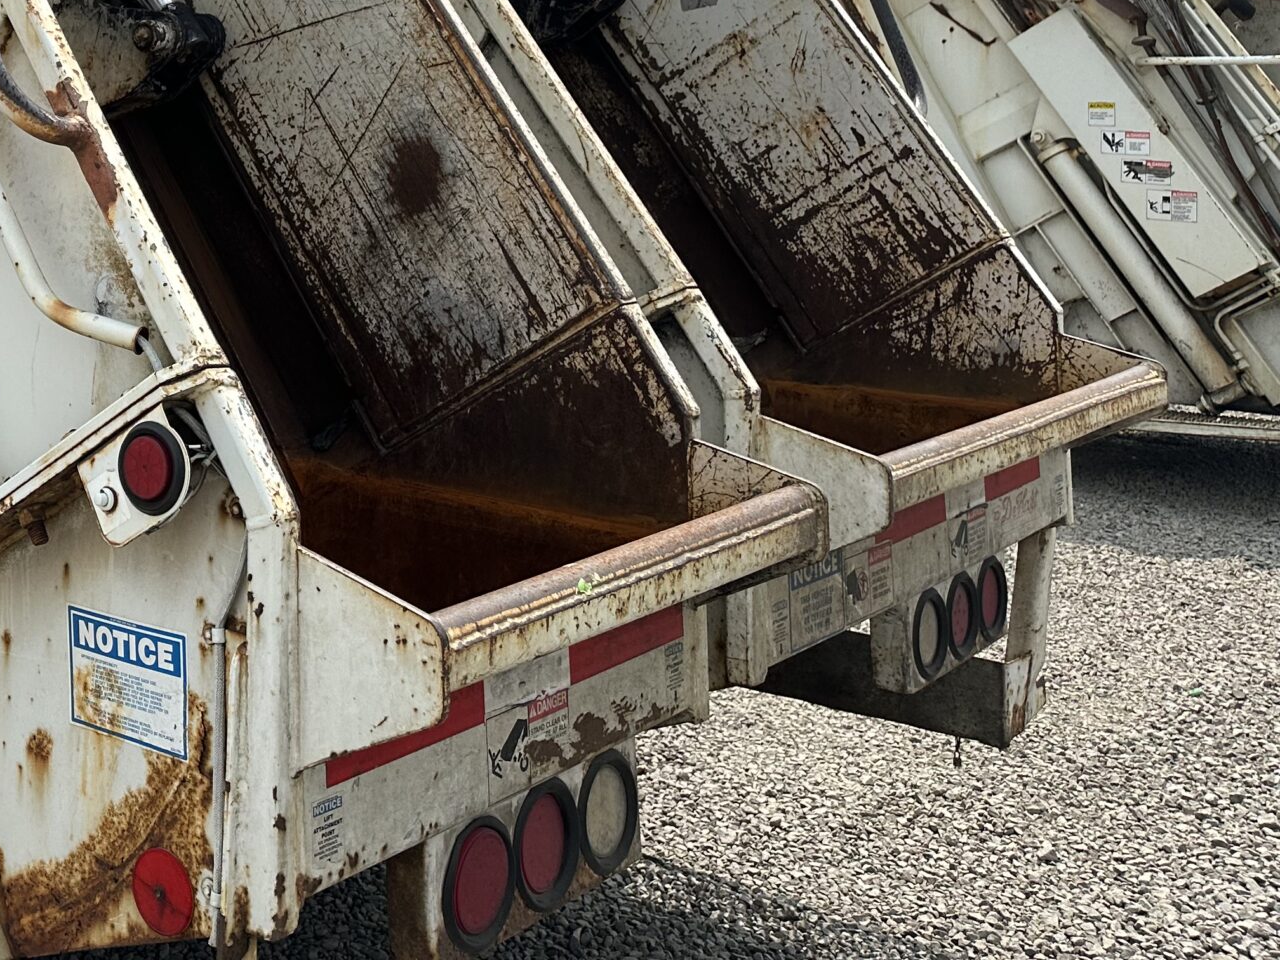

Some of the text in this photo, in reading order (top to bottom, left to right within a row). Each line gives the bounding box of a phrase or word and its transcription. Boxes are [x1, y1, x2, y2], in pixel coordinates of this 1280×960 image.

[78, 620, 174, 672] NOTICE
[537, 691, 567, 714] DANGER
[314, 797, 342, 816] NOTICE
[324, 814, 334, 822] LIFT
